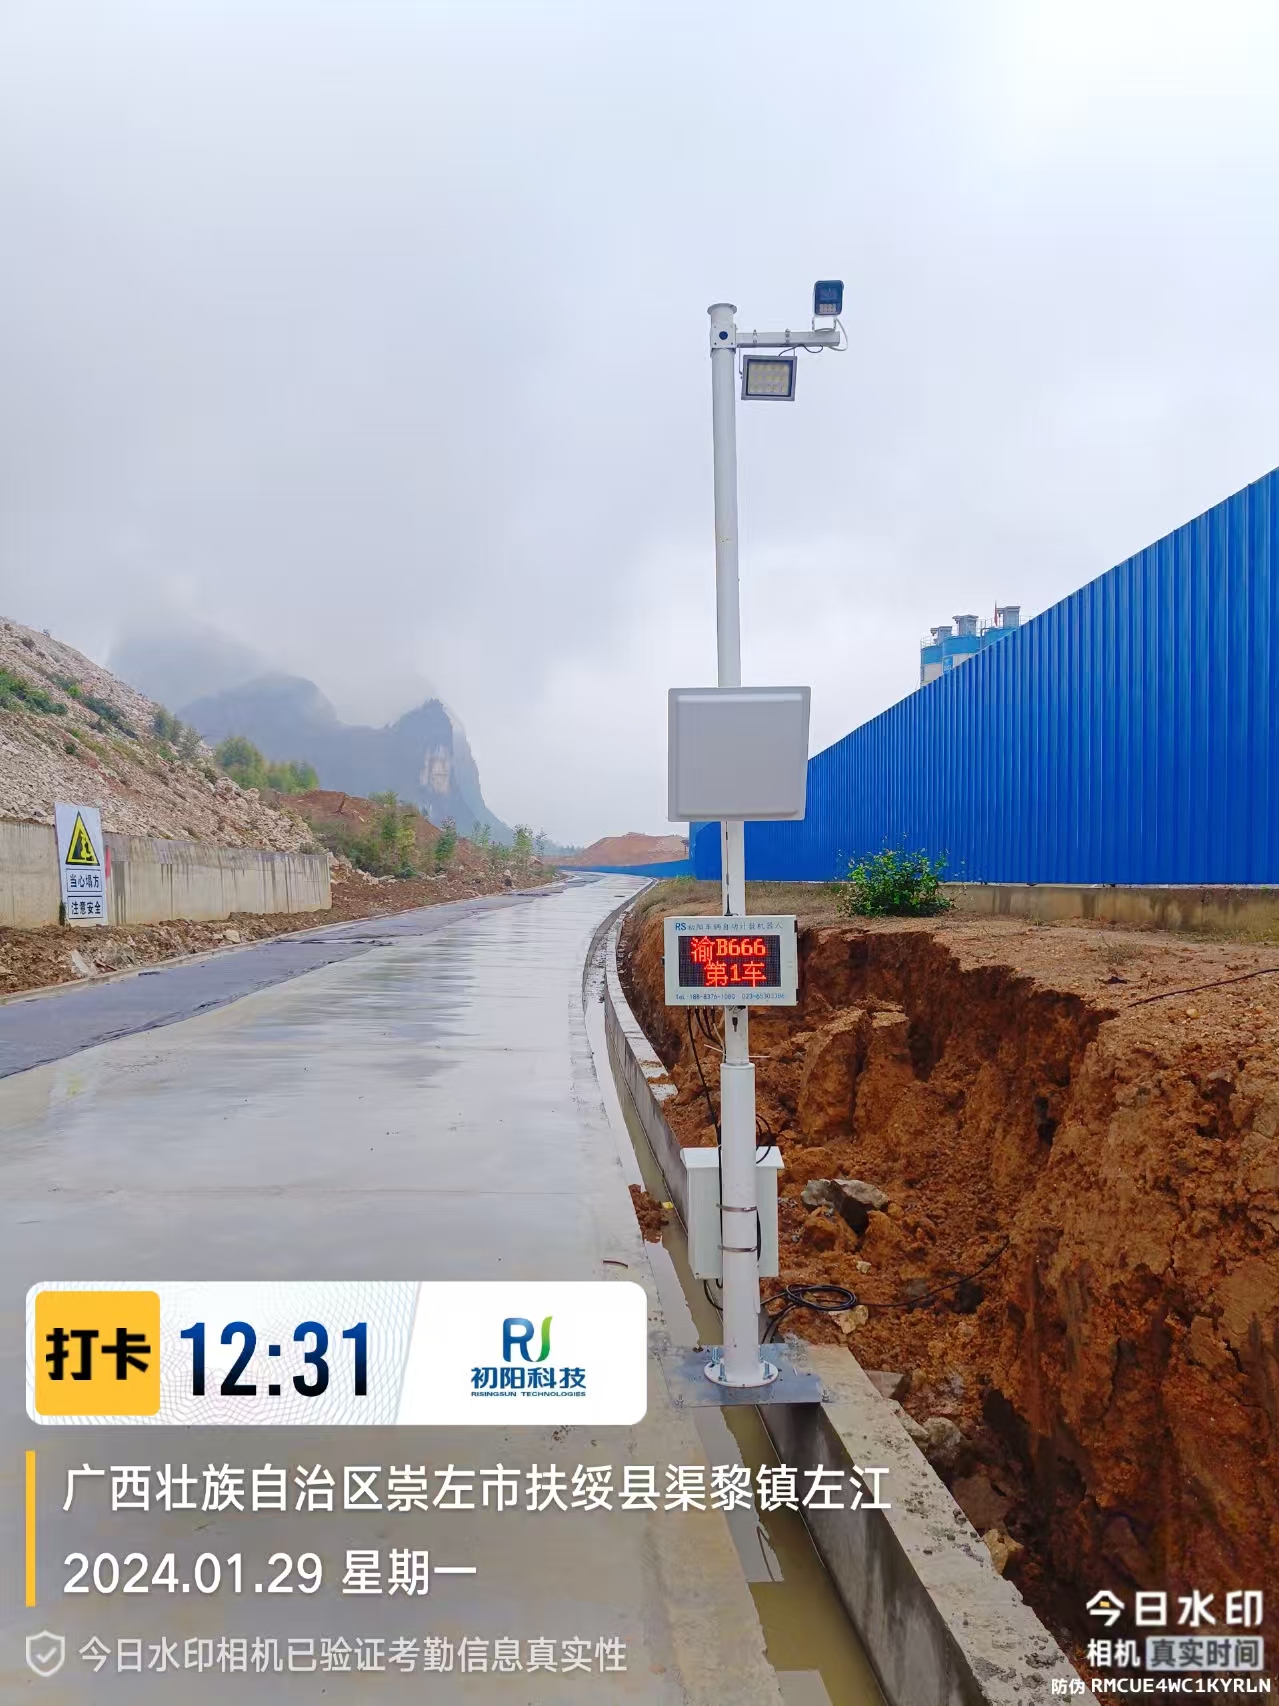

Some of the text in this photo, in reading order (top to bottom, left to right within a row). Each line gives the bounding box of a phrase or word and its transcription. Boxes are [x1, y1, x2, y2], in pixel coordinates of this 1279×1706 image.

[69, 874, 100, 888] 当心塌方
[71, 901, 101, 915] 注意安全
[675, 922, 687, 931] RS
[690, 936, 766, 962] 渝B666
[704, 961, 767, 987] 第1车
